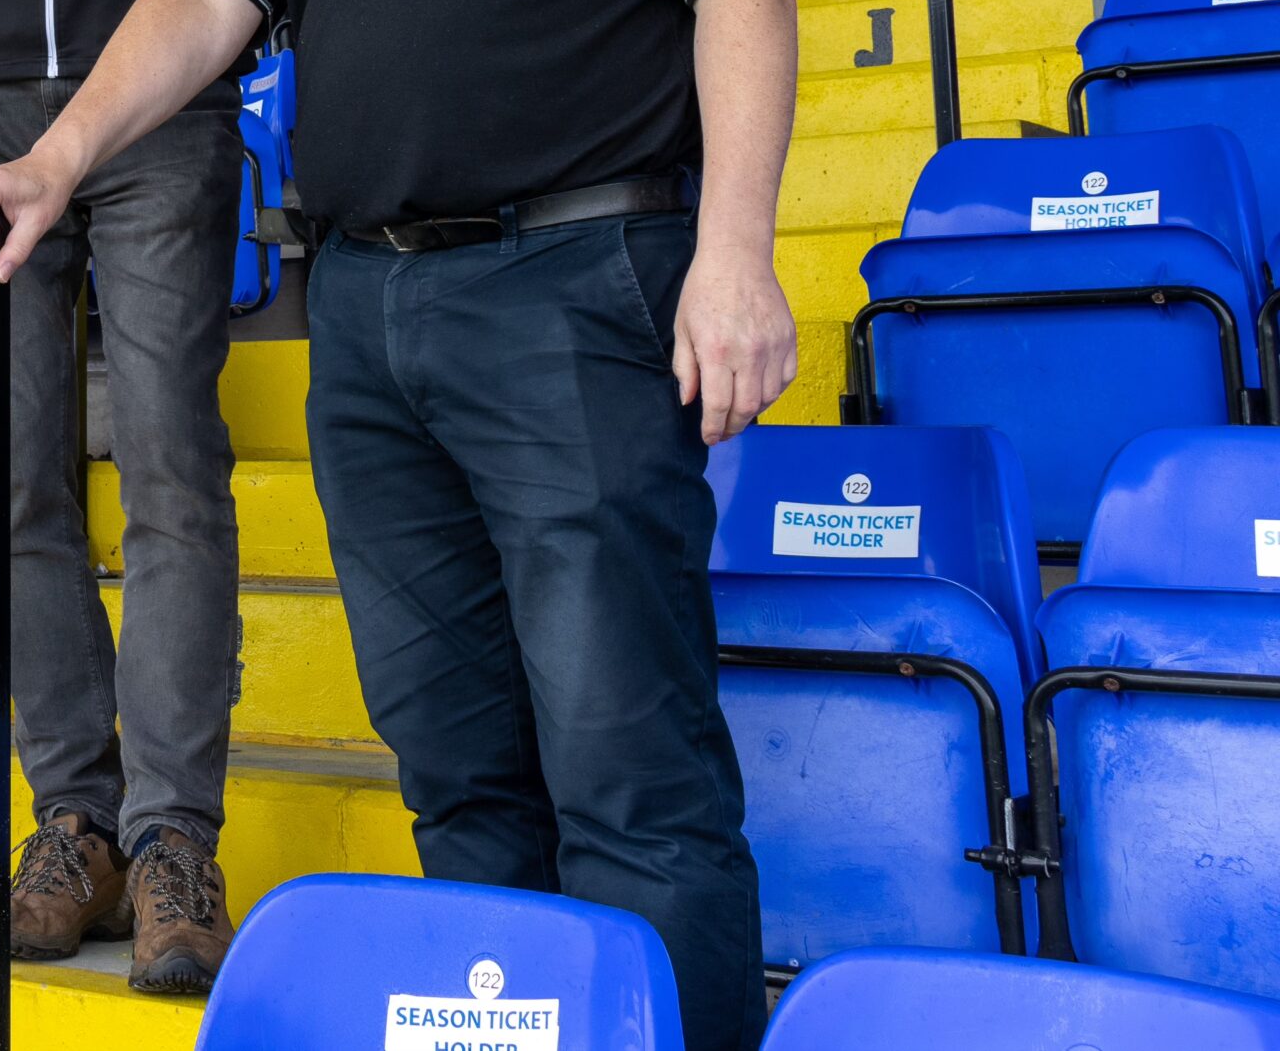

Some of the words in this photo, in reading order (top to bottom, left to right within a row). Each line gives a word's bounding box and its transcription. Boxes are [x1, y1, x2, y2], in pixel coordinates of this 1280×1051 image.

[854, 8, 895, 68] J
[1084, 177, 1105, 189] 122
[1037, 204, 1099, 216] SEASON
[1102, 198, 1154, 214] TICKET
[1065, 216, 1127, 230] HOLDER
[845, 482, 869, 495] 122
[782, 511, 853, 529] SEASON
[857, 515, 915, 530] TICKET
[814, 531, 884, 548] HOLDER
[472, 971, 501, 990] 122
[395, 1006, 482, 1029] SEASON
[486, 1010, 553, 1030] TICKET
